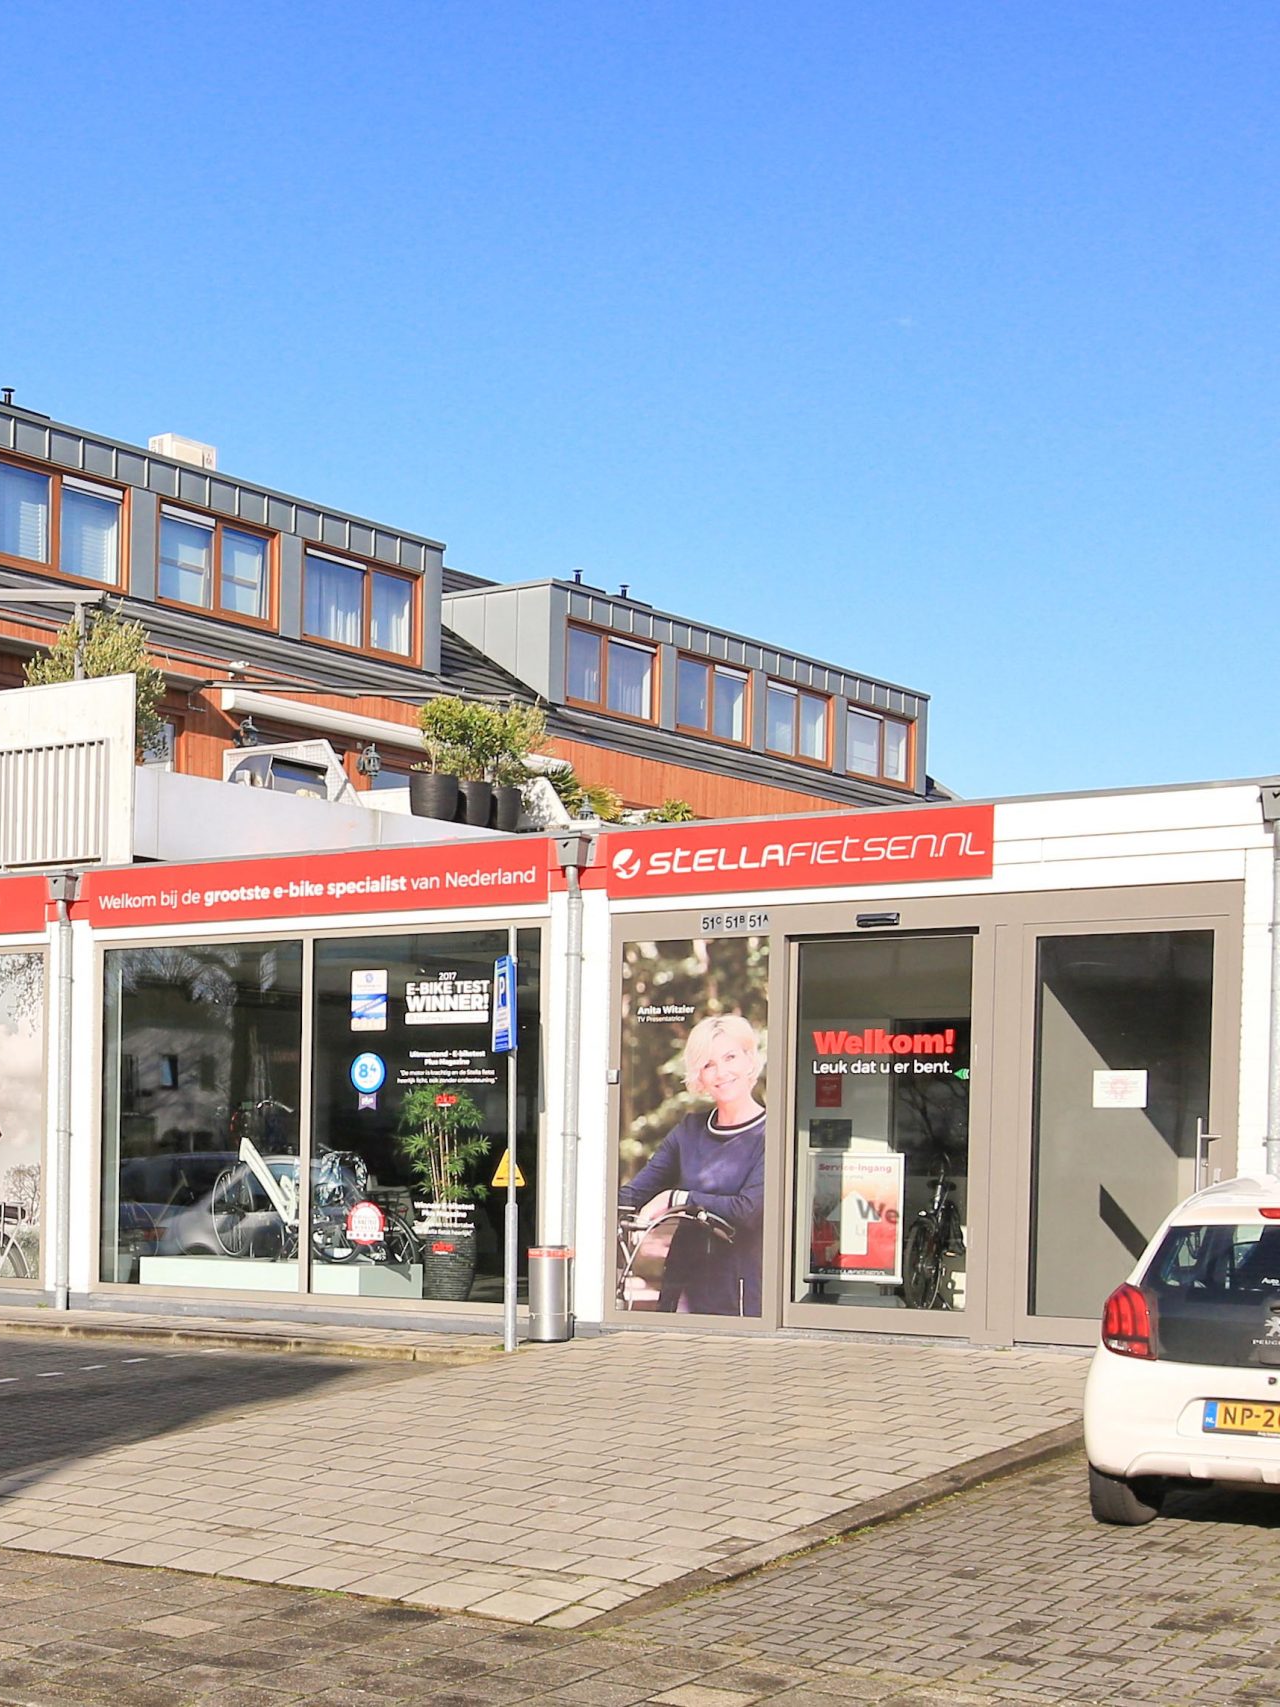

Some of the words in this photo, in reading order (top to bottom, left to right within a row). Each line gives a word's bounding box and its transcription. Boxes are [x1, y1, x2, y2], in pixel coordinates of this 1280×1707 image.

[98, 893, 156, 910] Welkom
[160, 891, 178, 909] bij
[181, 889, 200, 905] de
[204, 885, 270, 906] grootste
[273, 880, 324, 899] e-bike
[327, 874, 407, 898] specialist
[410, 875, 440, 891] van
[445, 866, 536, 888] Nederland
[438, 971, 457, 981] 2017
[406, 981, 455, 996] E-BIKE
[455, 980, 491, 994] TEST
[405, 993, 490, 1012] WINNER!
[637, 1005, 661, 1015] Anita
[662, 1004, 695, 1014] Witzier
[812, 1029, 955, 1055] Welkom!
[812, 1060, 848, 1075] Leuk
[850, 1059, 876, 1074] dat
[880, 1063, 890, 1074] u
[893, 1063, 909, 1074] er
[913, 1059, 953, 1074] bent.
[1205, 1416, 1215, 1424] NL
[1222, 1406, 1280, 1429] NP-2
